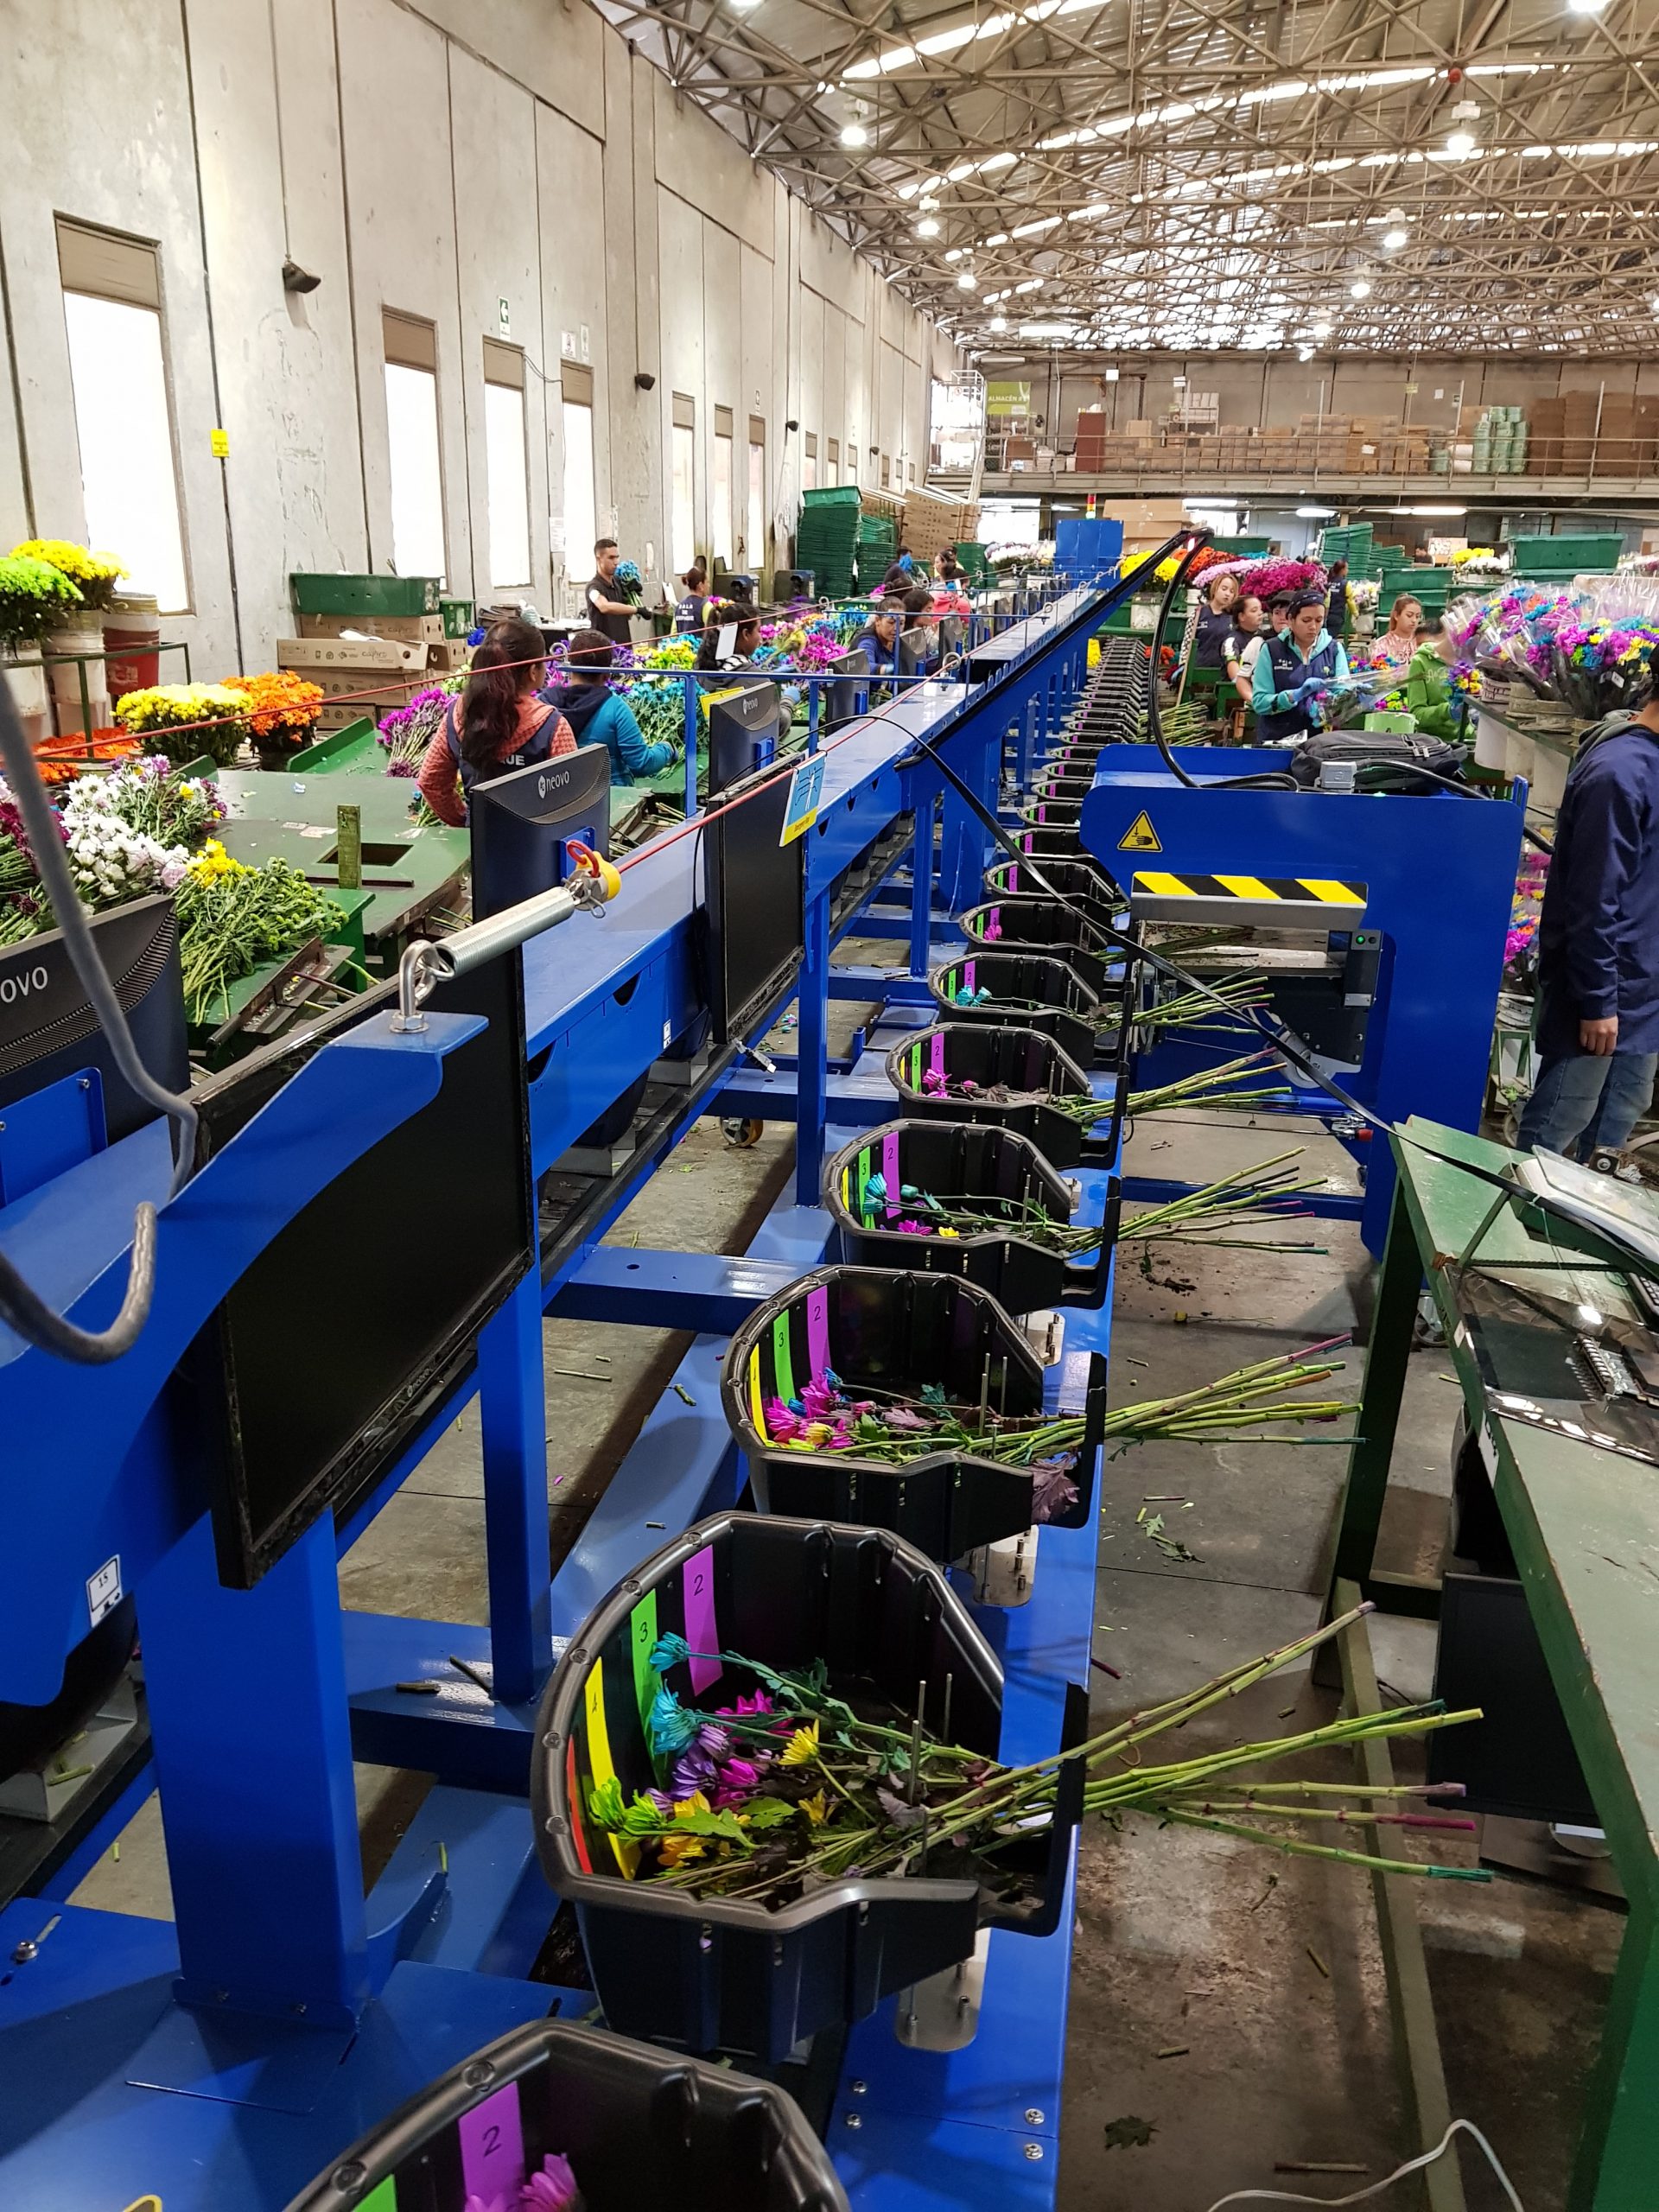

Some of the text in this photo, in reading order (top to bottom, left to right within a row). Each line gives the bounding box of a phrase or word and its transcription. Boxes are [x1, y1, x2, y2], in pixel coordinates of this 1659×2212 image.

[546, 771, 570, 792] neovo
[0, 966, 48, 1003] ovo
[935, 1046, 940, 1056] 2
[887, 1147, 893, 1160] 2
[813, 1306, 821, 1322] 2
[779, 1332, 785, 1348] 3
[98, 1572, 109, 1589] 15
[693, 1573, 703, 1597] 2
[639, 1621, 649, 1643] 3
[483, 2126, 501, 2158] 2
